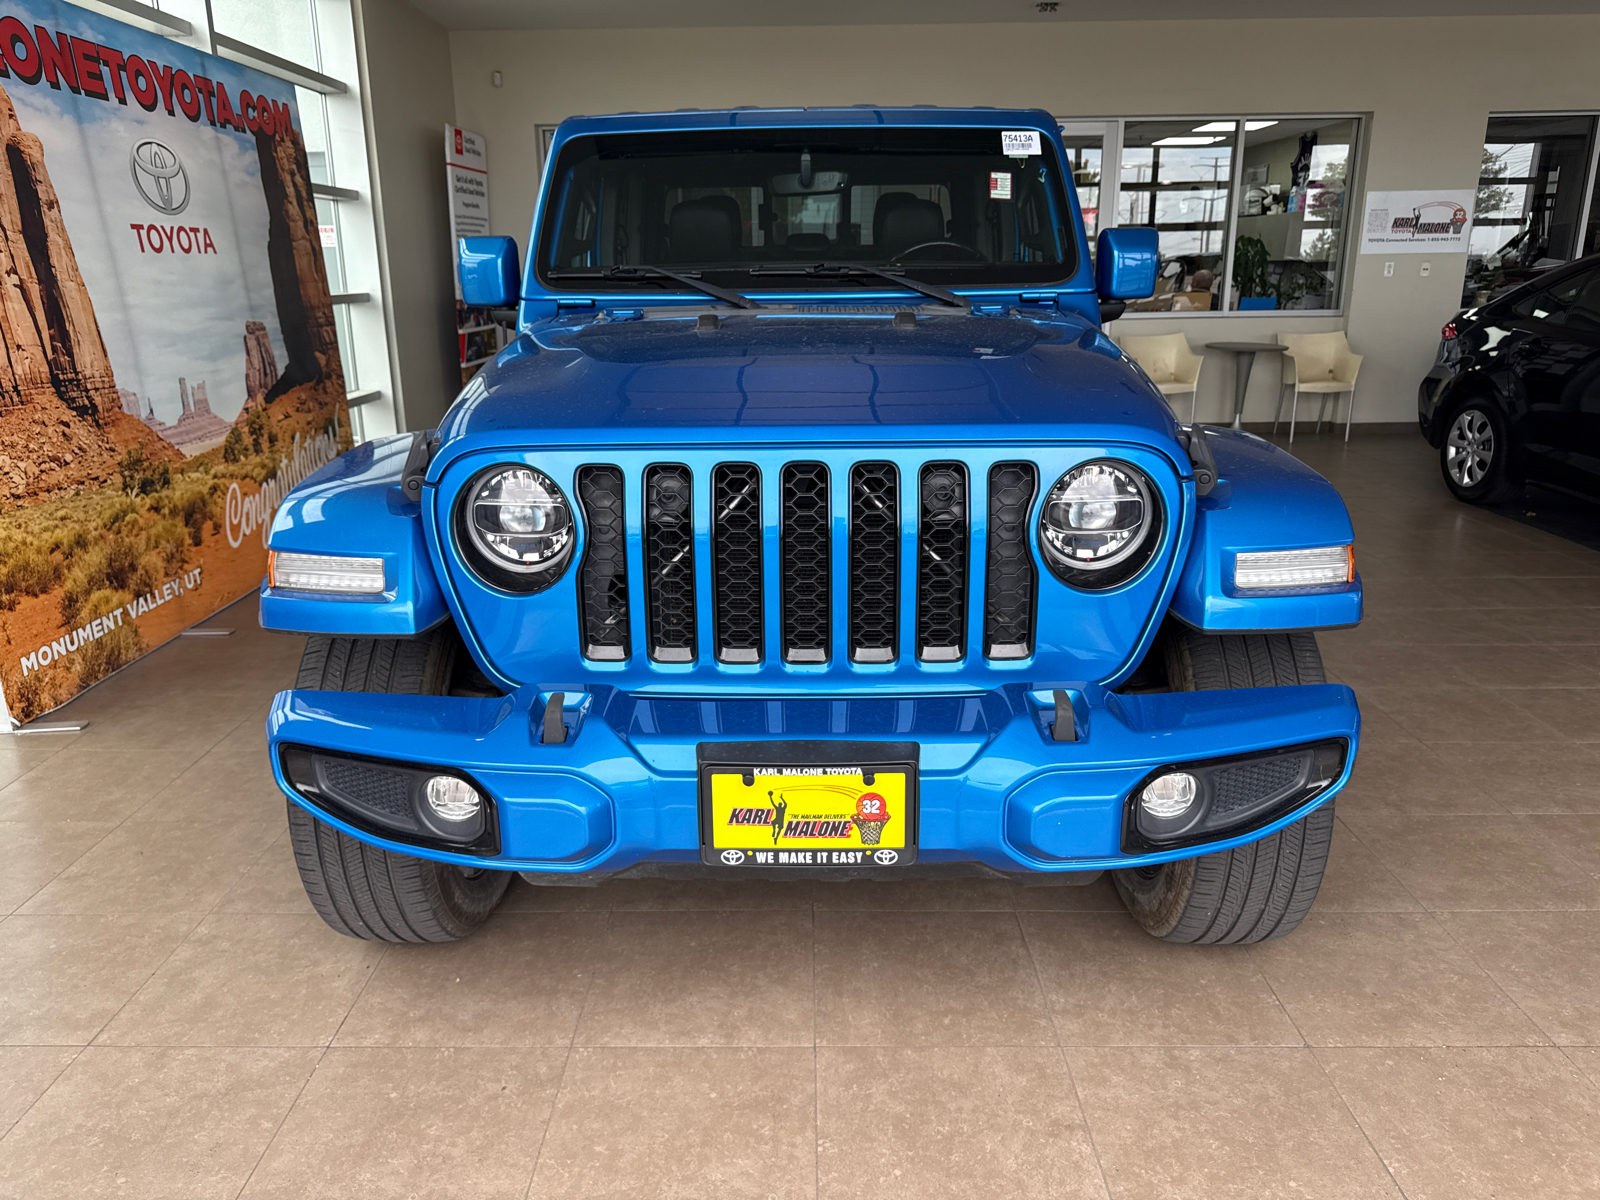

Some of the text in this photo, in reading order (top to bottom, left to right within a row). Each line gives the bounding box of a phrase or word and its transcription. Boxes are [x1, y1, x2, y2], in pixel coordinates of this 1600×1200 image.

[0, 15, 295, 140] ONETOYOTA.COM
[1003, 134, 1034, 143] 75413A
[1391, 217, 1415, 228] KARL
[1416, 222, 1452, 234] MALONE
[129, 223, 218, 255] TOYOTA
[19, 567, 202, 677] MONUMENT VALLEY, UT
[753, 767, 863, 776] KARL MALONE TOYOTA
[862, 799, 881, 814] 32
[727, 808, 774, 826] KARL
[782, 820, 854, 839] MALONE
[756, 852, 863, 864] WE MAKE IT EASY
